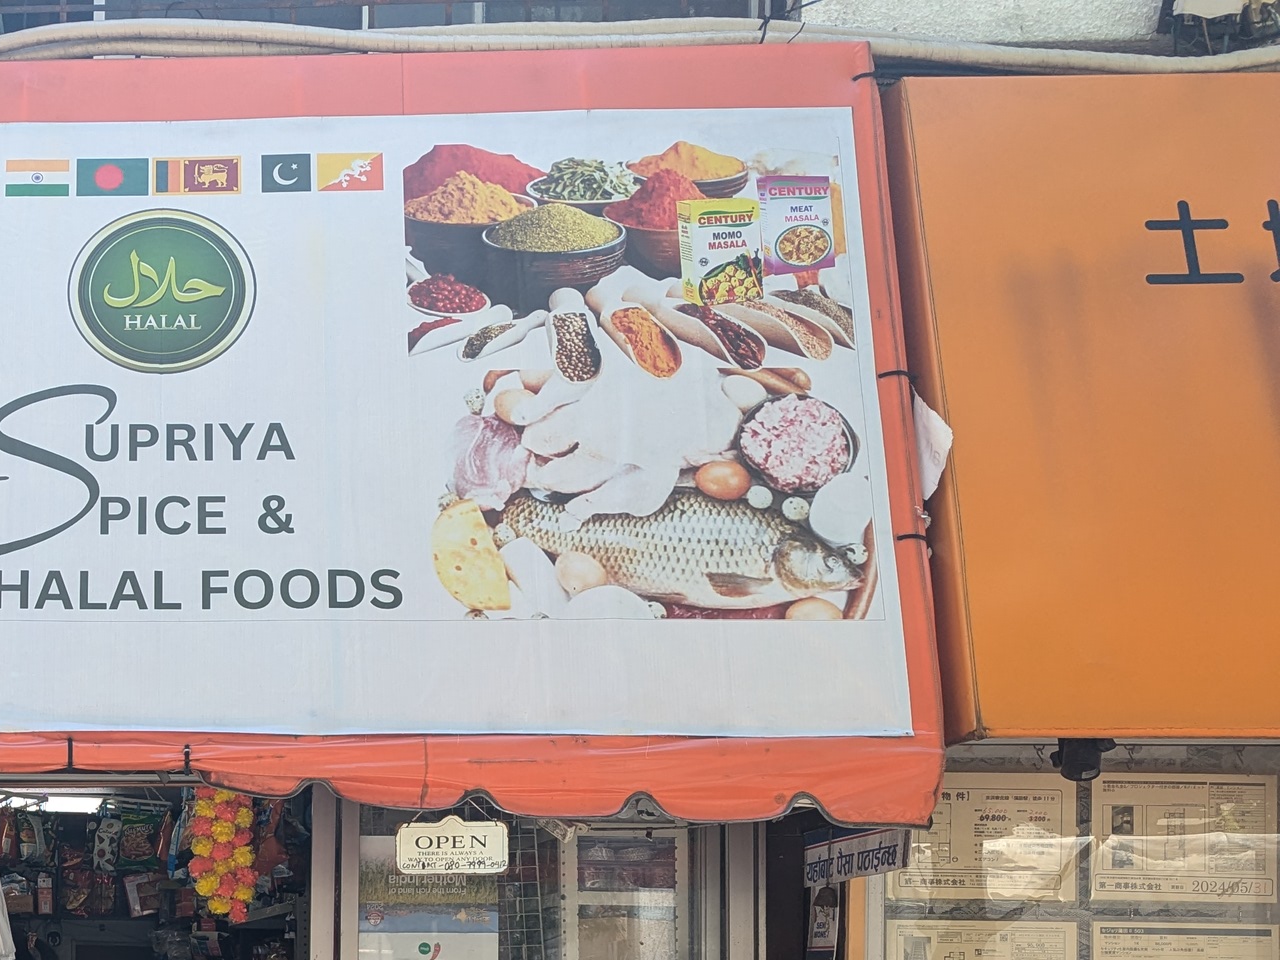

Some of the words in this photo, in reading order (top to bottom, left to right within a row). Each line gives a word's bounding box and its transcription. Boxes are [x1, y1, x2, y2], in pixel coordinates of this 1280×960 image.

[769, 185, 828, 196] CENTURY
[698, 214, 753, 225] CENTURY
[785, 214, 819, 222] MASALA
[712, 231, 742, 240] MOMO
[708, 240, 747, 250] MASALA
[103, 249, 226, 308] حلال
[123, 314, 202, 331] HALAL
[257, 495, 295, 534] &
[201, 569, 404, 610] FOODS
[415, 835, 488, 849] OPEN
[1098, 881, 1162, 891] 第一商事株式会社
